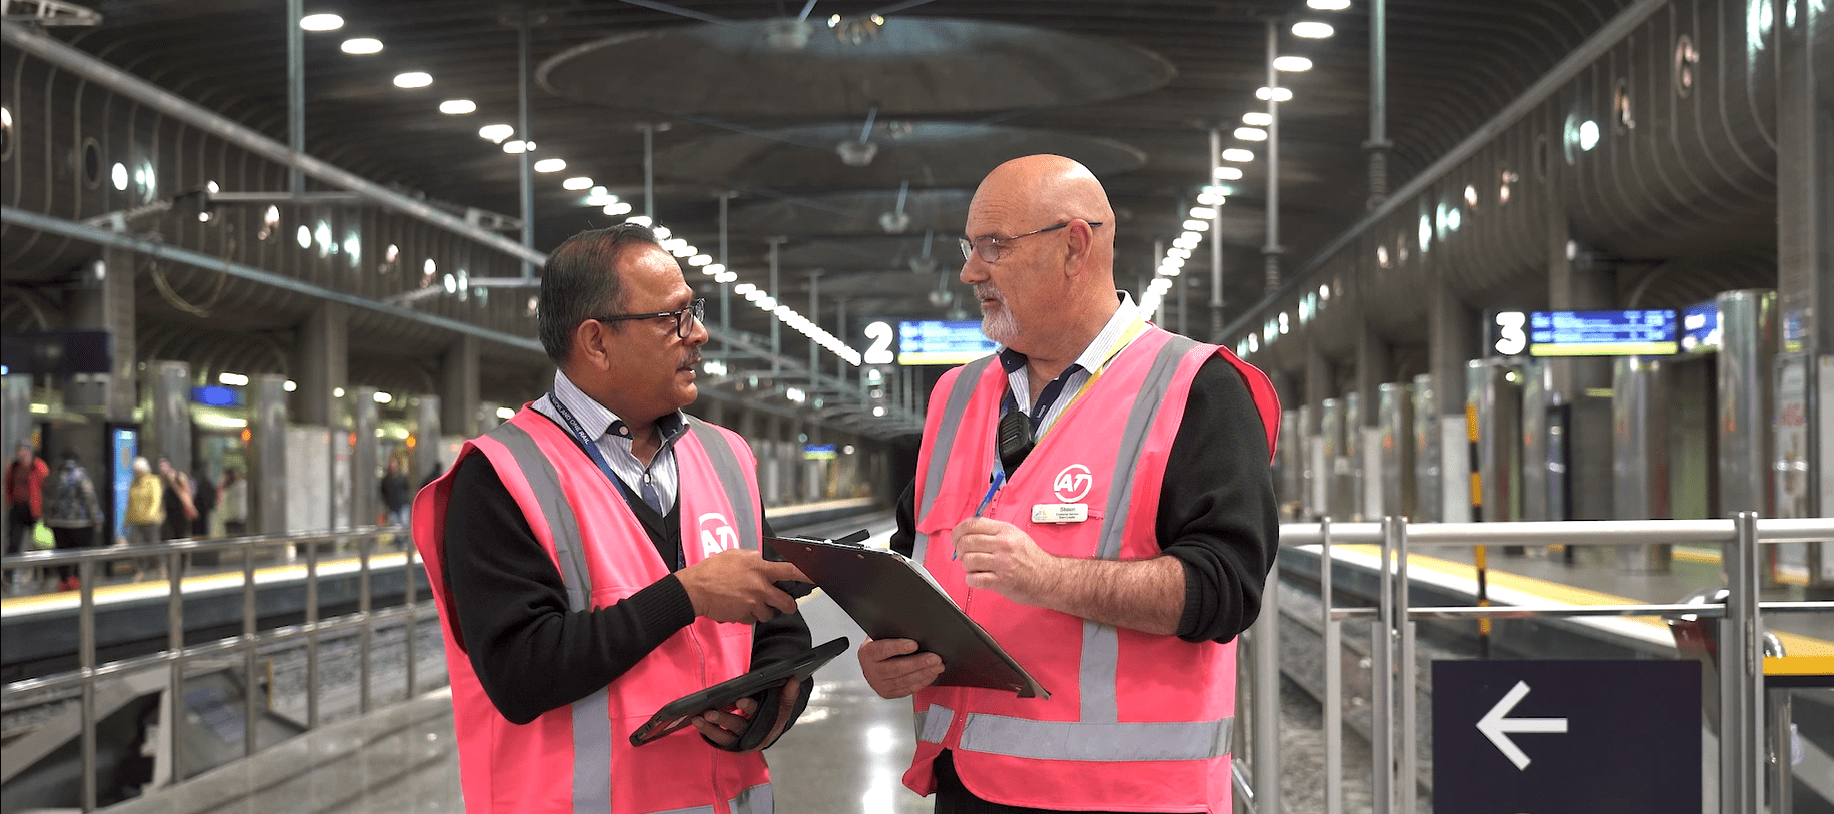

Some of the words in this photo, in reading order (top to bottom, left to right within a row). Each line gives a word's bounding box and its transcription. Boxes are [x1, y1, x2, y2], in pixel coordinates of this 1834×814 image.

[864, 320, 894, 364] 2
[1494, 311, 1527, 355] 3
[578, 430, 590, 445] RAIL
